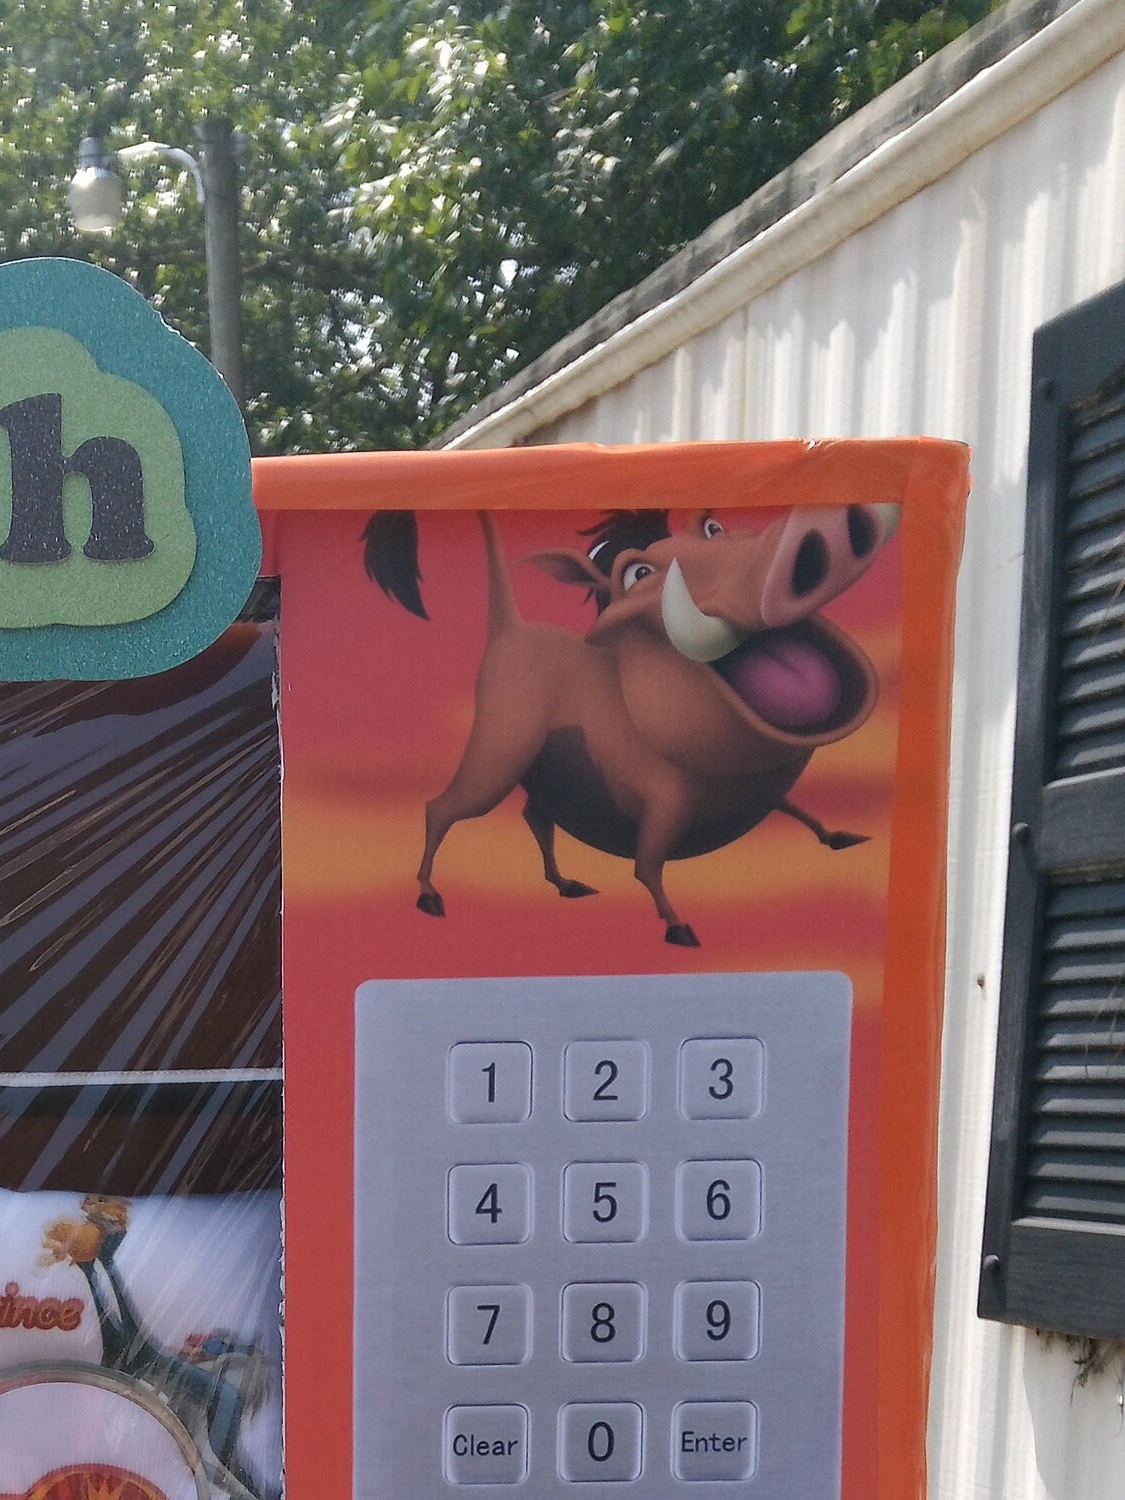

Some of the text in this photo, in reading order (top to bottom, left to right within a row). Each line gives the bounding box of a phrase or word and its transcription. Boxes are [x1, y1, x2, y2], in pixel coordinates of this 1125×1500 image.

[481, 1058, 734, 1103] 1 2 3
[475, 1179, 731, 1224] 4 5 6
[476, 1299, 731, 1345] 7 8 9
[452, 1421, 748, 1463] Clear 0 Enter
